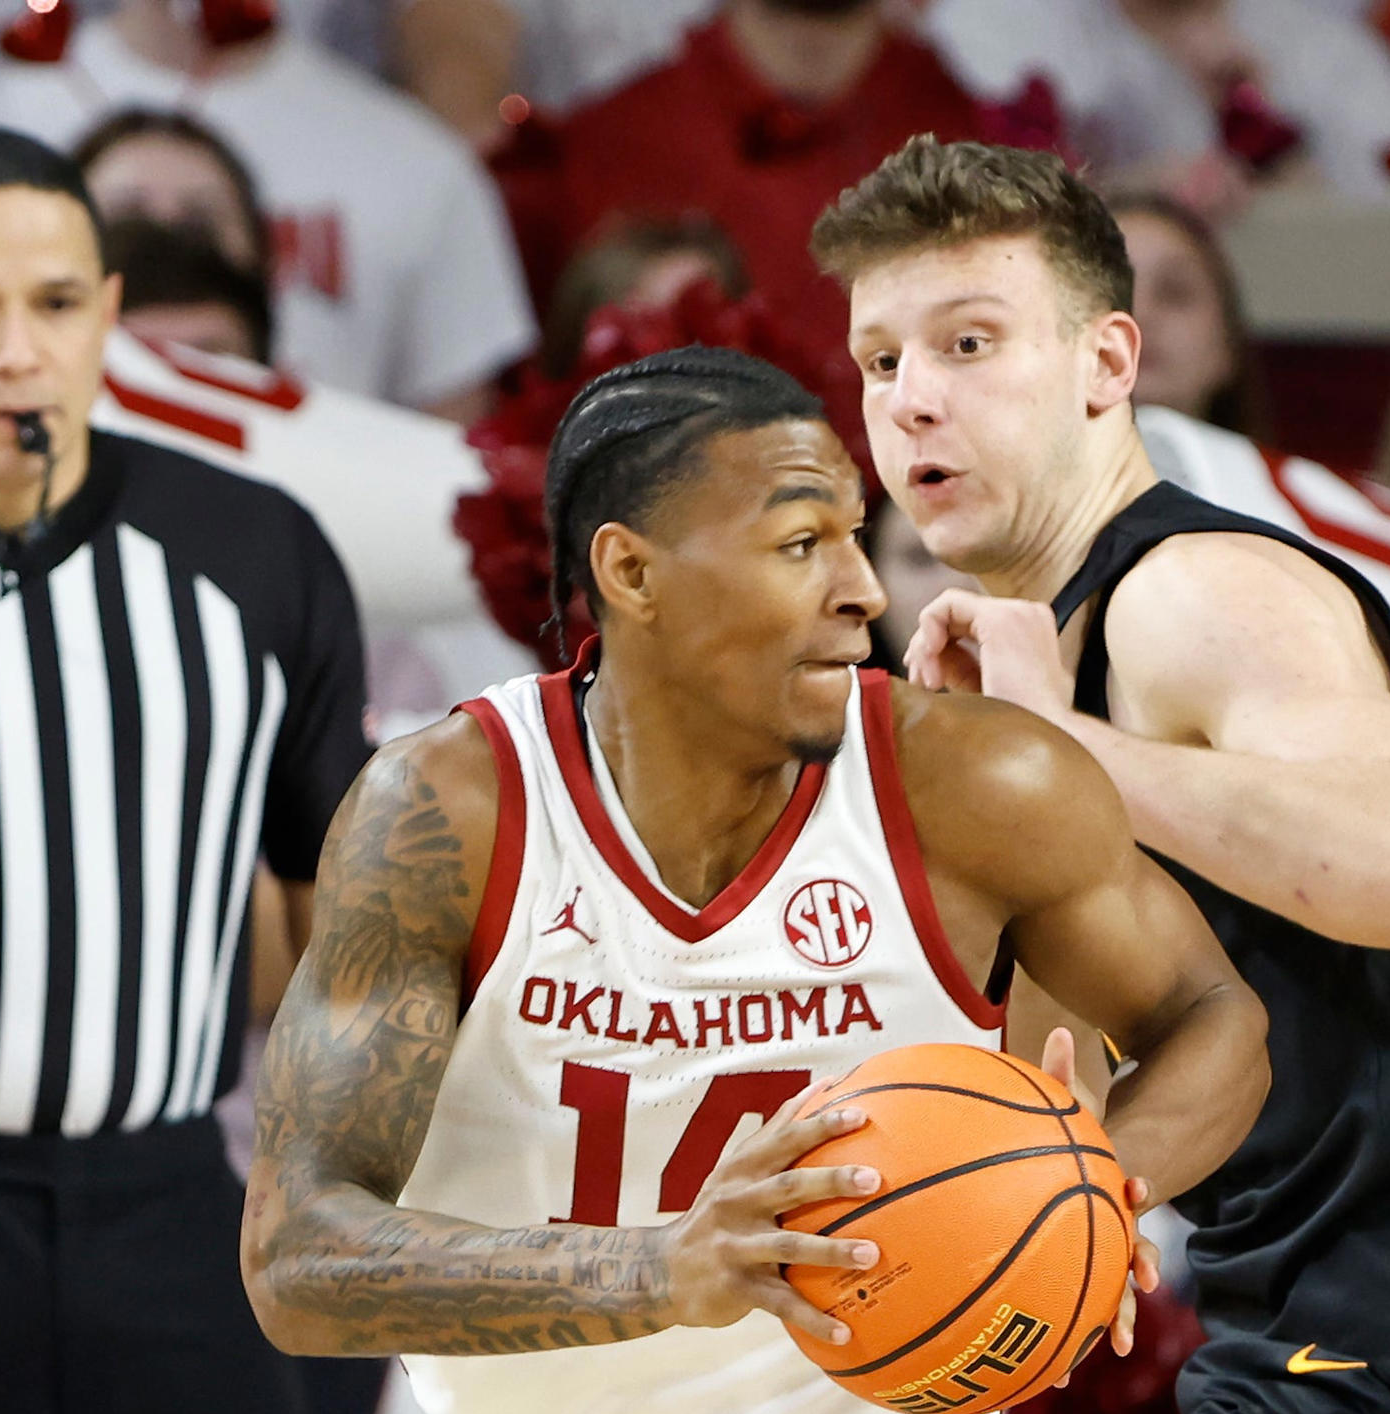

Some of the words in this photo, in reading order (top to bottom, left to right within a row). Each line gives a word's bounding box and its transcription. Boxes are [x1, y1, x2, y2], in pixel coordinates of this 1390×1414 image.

[785, 879, 871, 965] SEC
[518, 975, 883, 1049] OKLAHOMA
[885, 1309, 1053, 1414] ELITE
